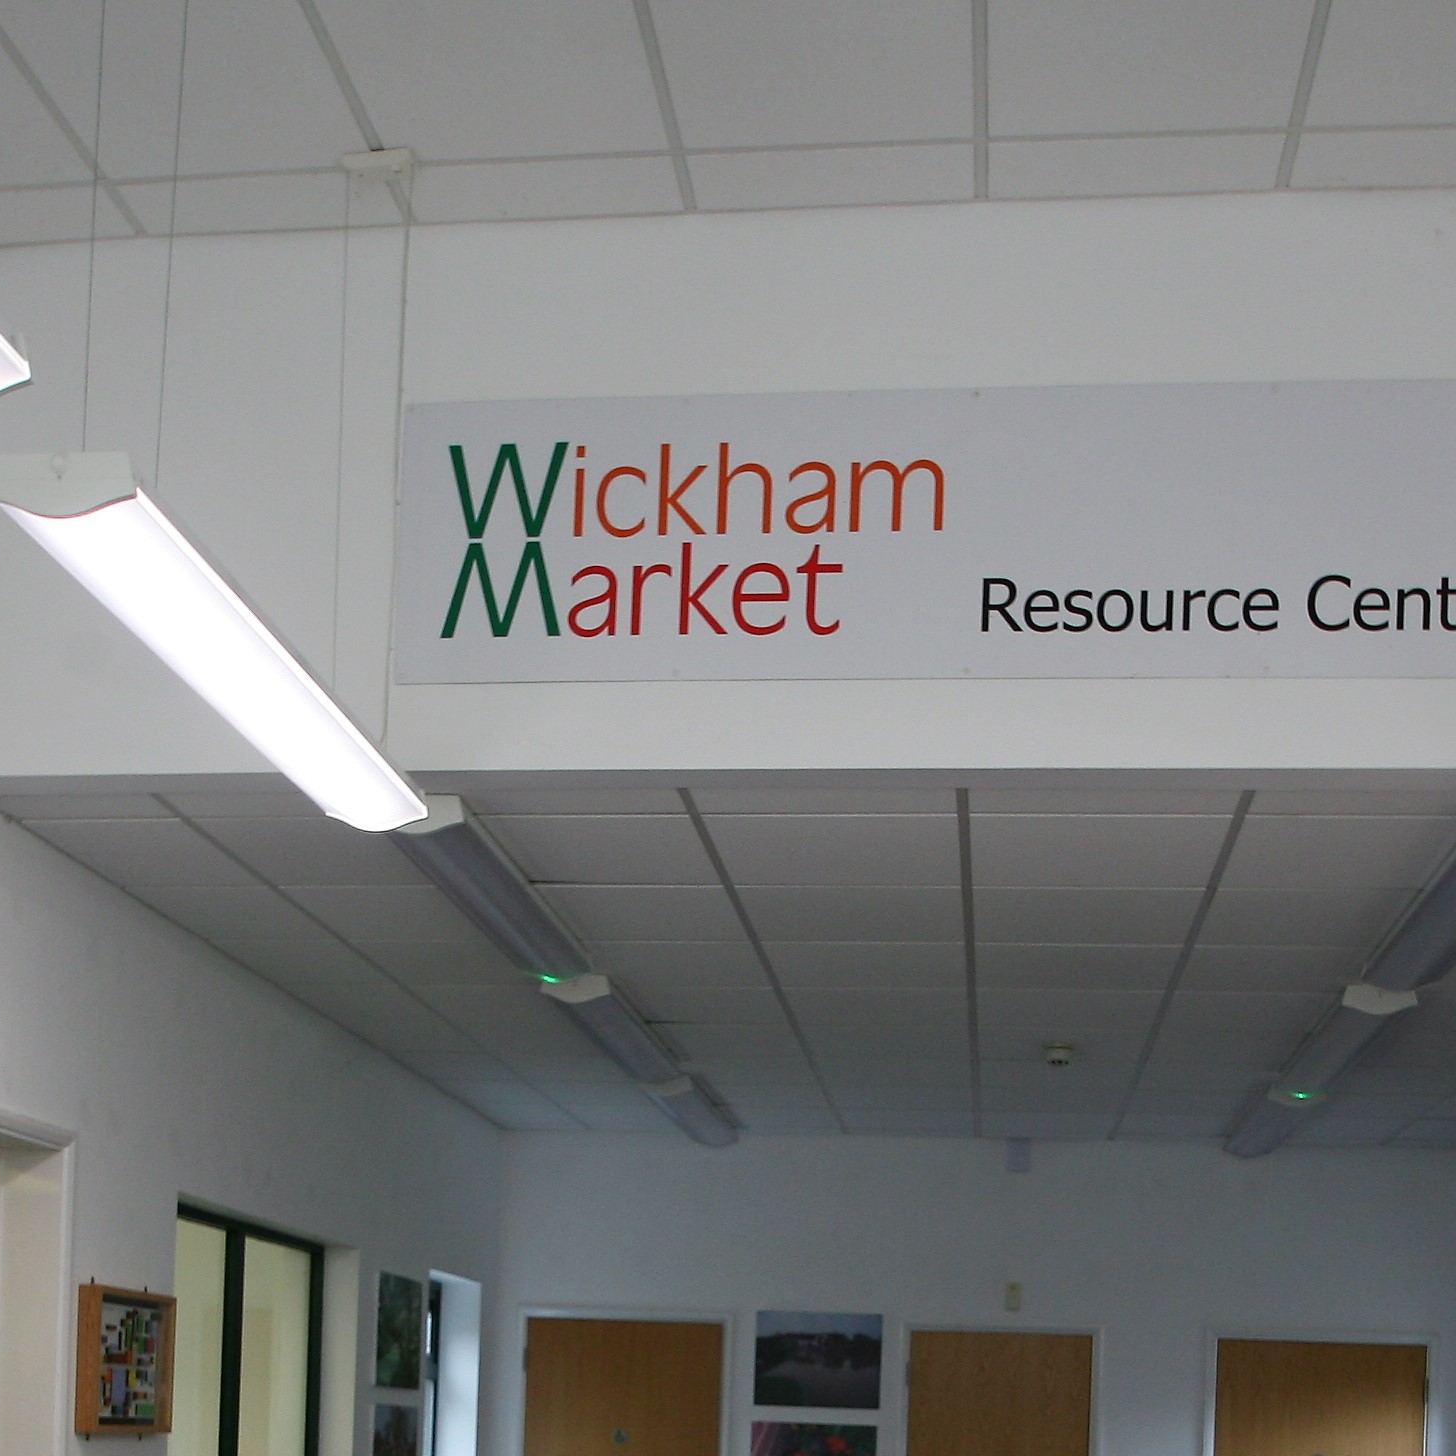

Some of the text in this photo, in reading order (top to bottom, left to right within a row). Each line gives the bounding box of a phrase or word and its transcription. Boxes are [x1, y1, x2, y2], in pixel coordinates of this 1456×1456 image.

[448, 441, 945, 540] Wickham
[440, 540, 844, 639] Market
[979, 576, 1280, 634] Resource
